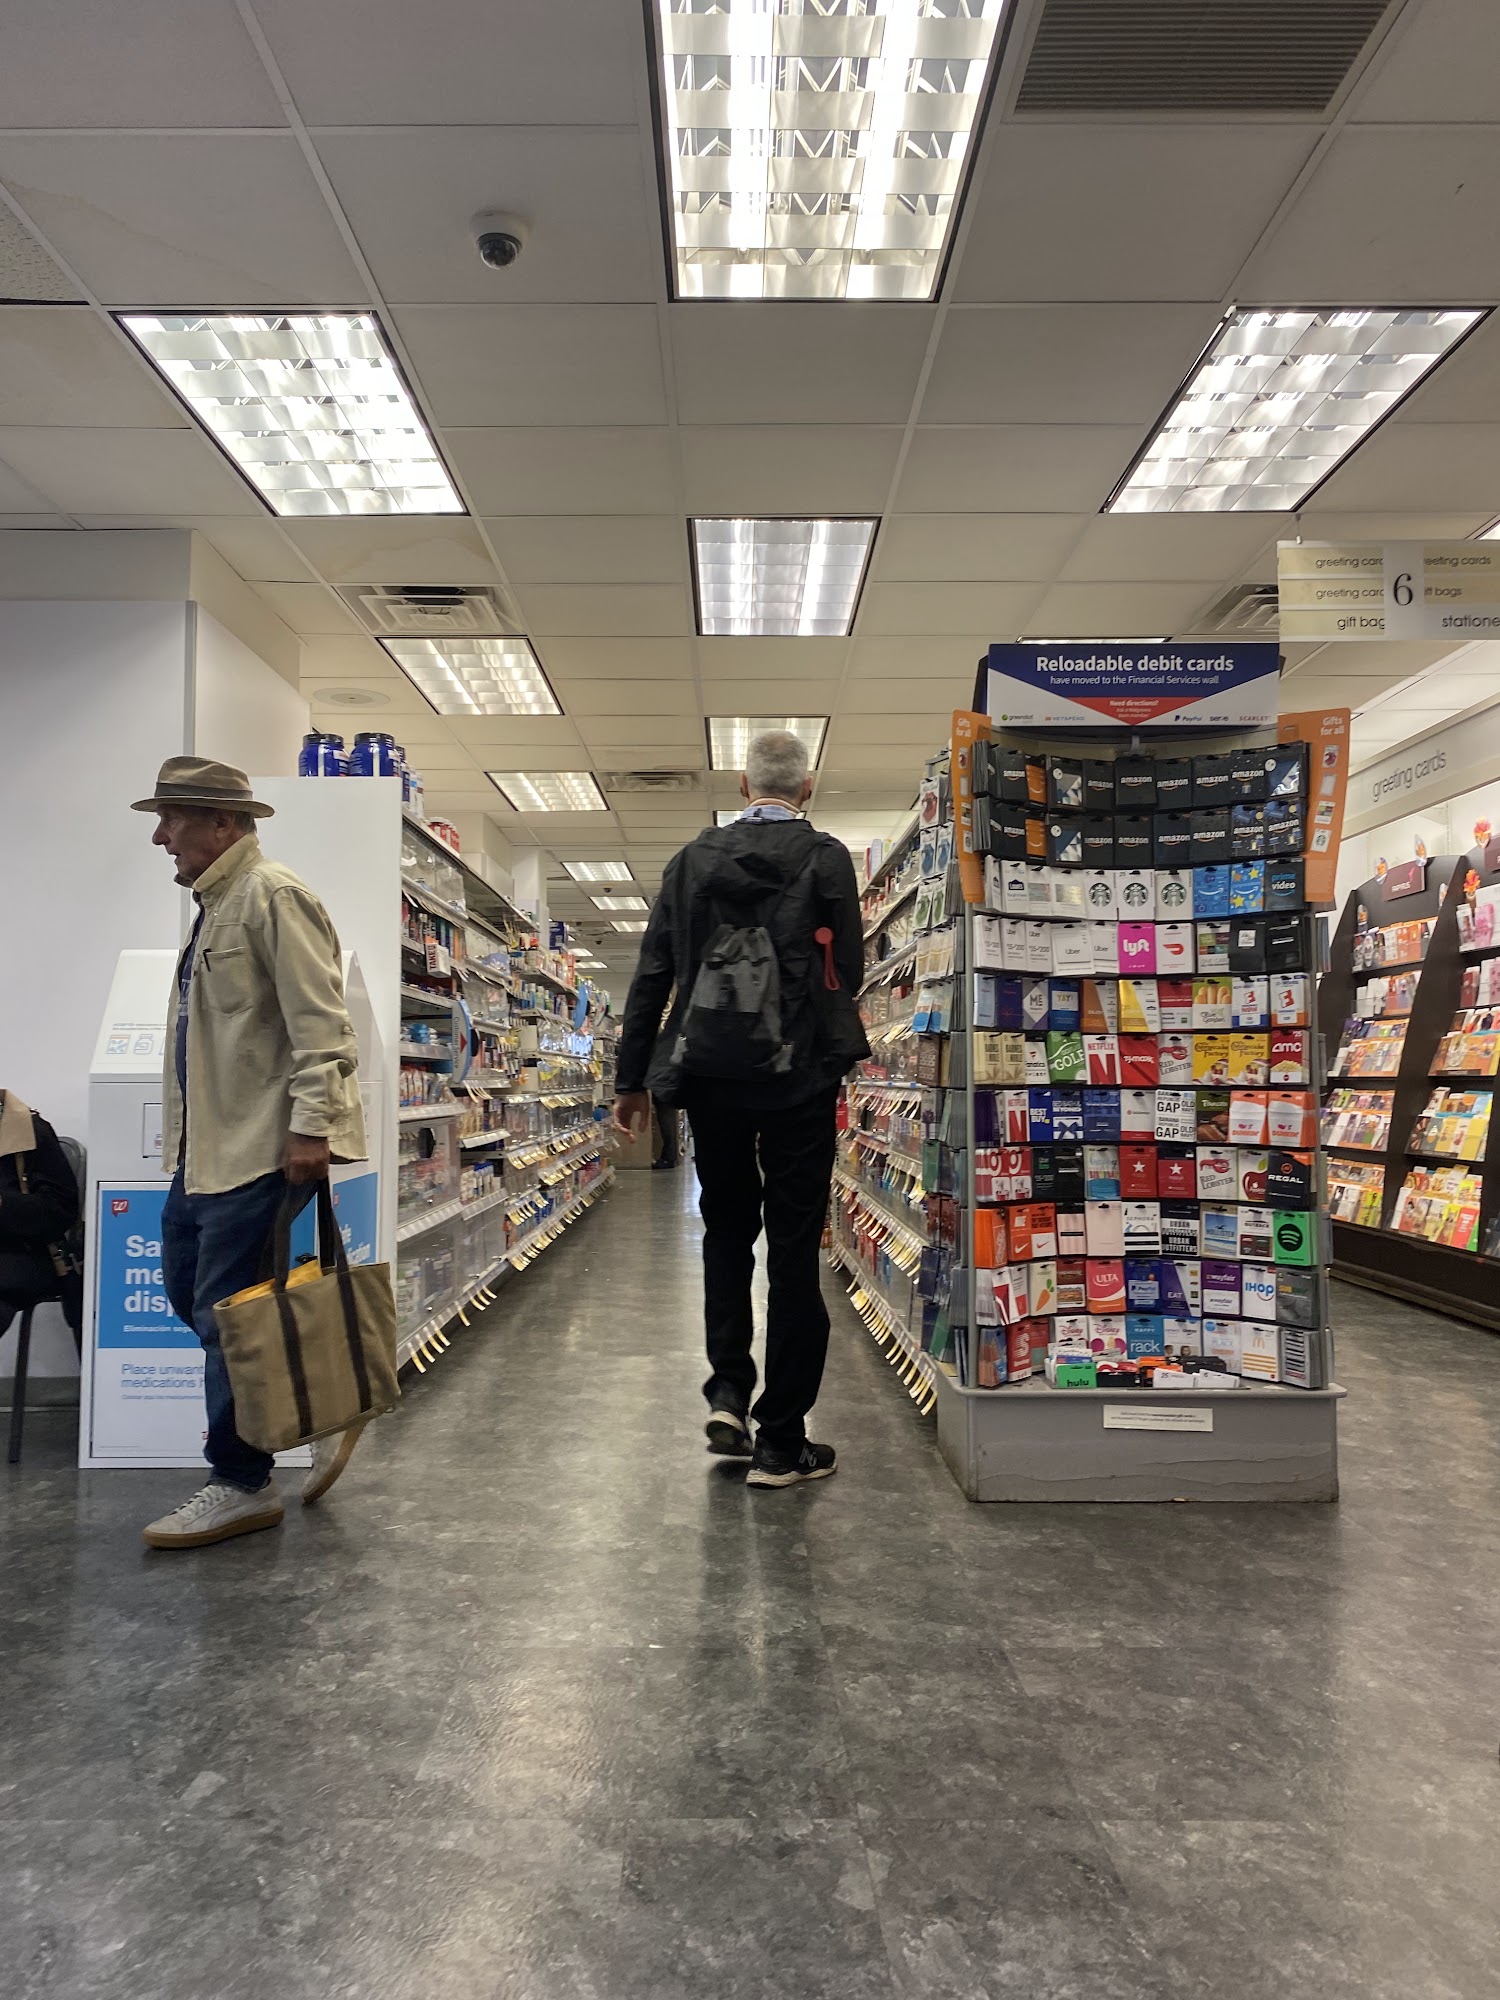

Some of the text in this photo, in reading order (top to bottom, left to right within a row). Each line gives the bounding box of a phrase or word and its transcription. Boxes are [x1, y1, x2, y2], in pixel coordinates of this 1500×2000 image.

[1315, 557, 1359, 568] greeting
[1461, 556, 1492, 566] cards
[1315, 588, 1359, 599] greeting
[1393, 573, 1414, 606] 6
[1434, 587, 1463, 598] bags
[1337, 616, 1356, 630] gift
[1036, 655, 1235, 672] Reloadable debit cards
[1050, 676, 1220, 685] have moved to the Financial Services wall
[1322, 716, 1344, 727] Gifts
[1320, 726, 1345, 736] for all
[1003, 770, 1026, 778] amazon
[1232, 769, 1265, 779] amazon
[1372, 750, 1447, 803] greeting cards
[1088, 780, 1114, 789] amazon
[1120, 776, 1153, 784] amazon
[1157, 778, 1189, 788] amazon
[1196, 775, 1229, 785] amazon
[1233, 825, 1264, 835] amazon
[1268, 819, 1300, 832] amazon
[1003, 826, 1026, 836] amazon
[1193, 831, 1226, 839] amazon
[1158, 834, 1191, 843] amazon
[1271, 872, 1296, 882] prime
[1271, 881, 1296, 890] video
[1122, 939, 1150, 956] lyft
[428, 951, 437, 970] TAKE
[1029, 994, 1044, 1007] ME
[1087, 1043, 1115, 1051] NETFLIX
[1054, 1049, 1085, 1071] GOLF
[1160, 1062, 1193, 1075] LOBSTER
[1157, 1101, 1181, 1113] GAP
[1181, 1100, 1195, 1108] OLD
[1030, 1108, 1047, 1116] BEST
[1031, 1115, 1046, 1123] BUY
[1156, 1126, 1179, 1138] GAP
[1201, 1177, 1236, 1190] LOBSTER
[1268, 1174, 1304, 1184] REGAL
[126, 1235, 163, 1258] Sa
[1095, 1274, 1119, 1283] ULTA
[1210, 1274, 1236, 1282] wayfair
[1167, 1291, 1183, 1299] EAT
[123, 1325, 172, 1333] Eliminación
[1130, 1340, 1160, 1353] rack
[121, 1363, 156, 1375] Place
[120, 1377, 197, 1388] medications
[1066, 1379, 1090, 1387] hulu
